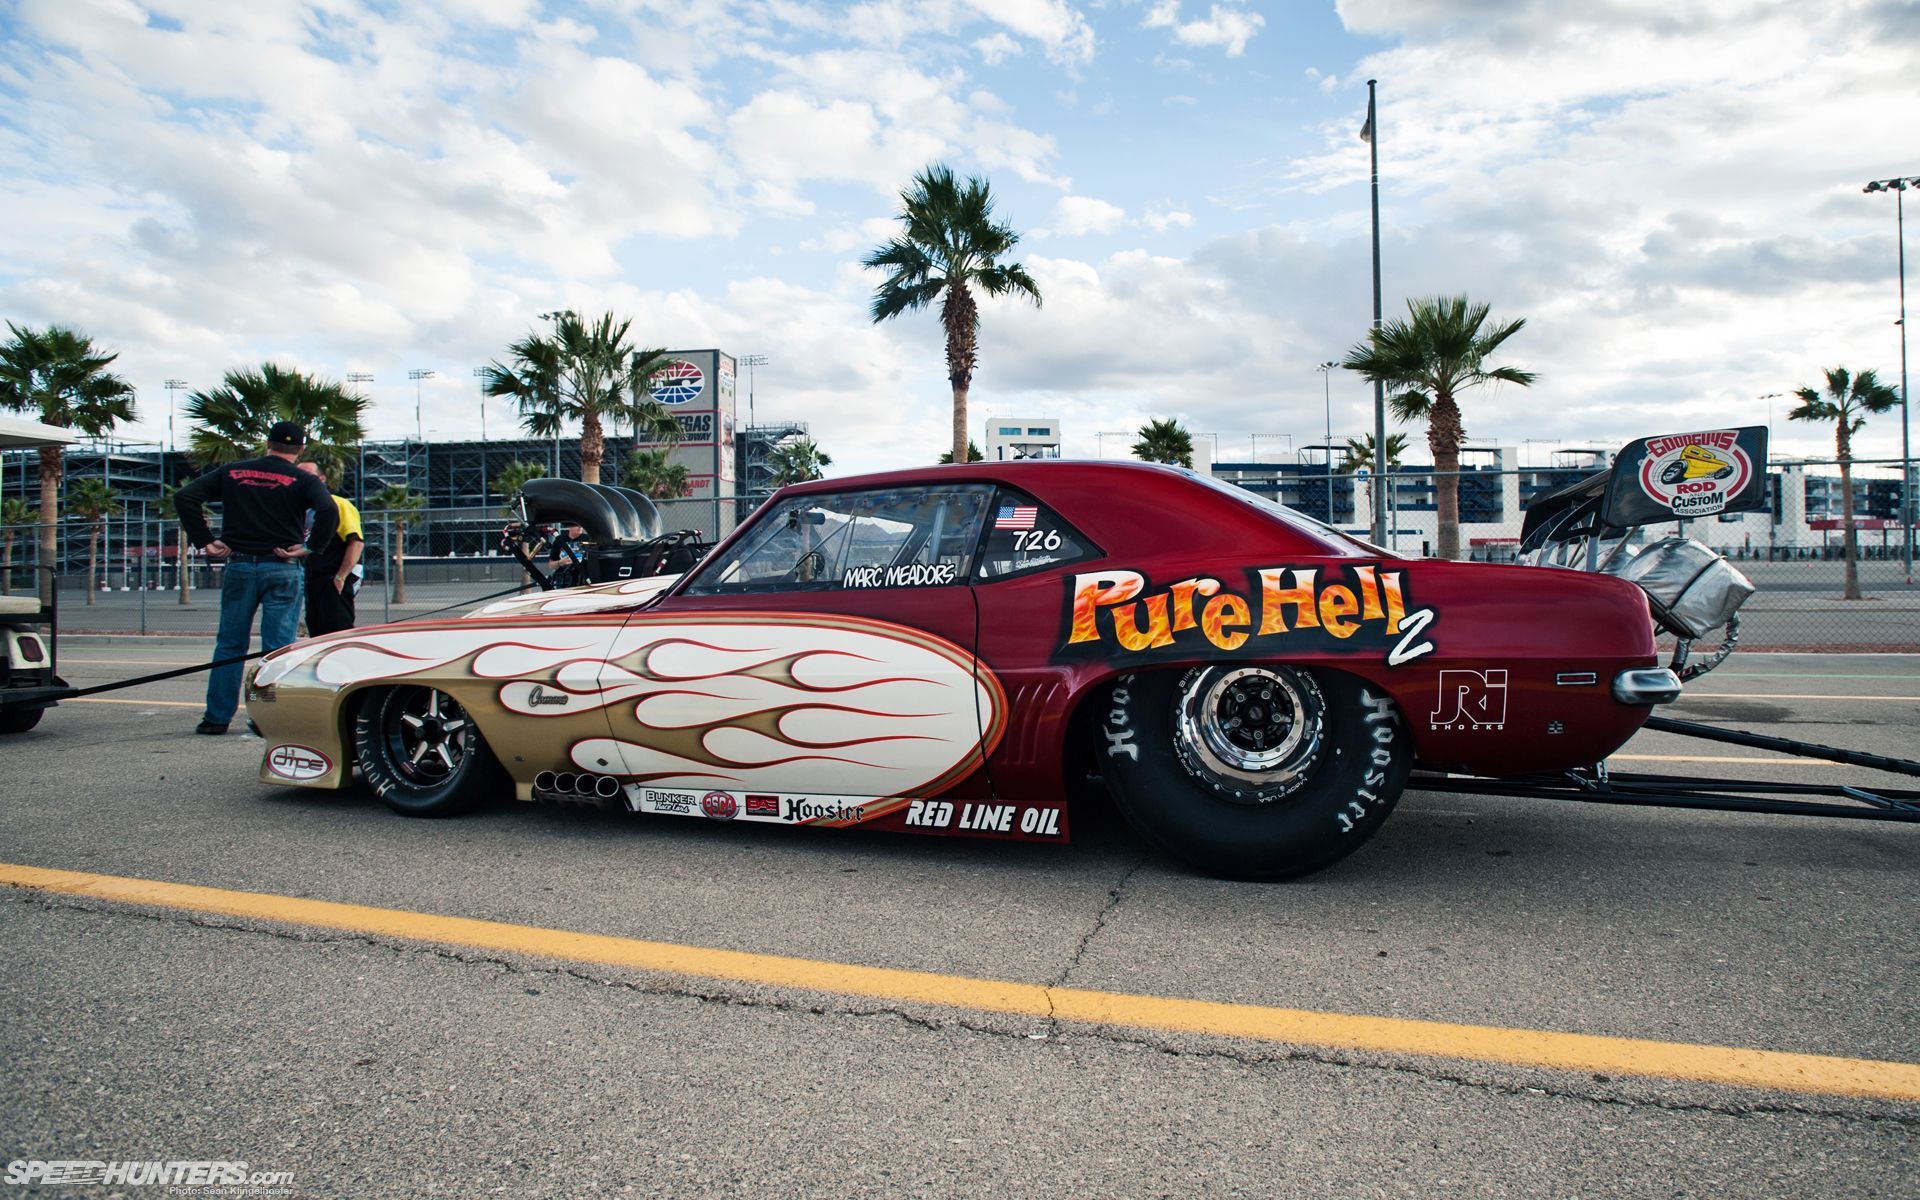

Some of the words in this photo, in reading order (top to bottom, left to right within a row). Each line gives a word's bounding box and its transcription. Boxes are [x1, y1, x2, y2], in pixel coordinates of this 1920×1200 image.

[1647, 432, 1737, 458] GOODGUYS
[1676, 481, 1717, 494] ROD
[1674, 504, 1723, 515] ASSOCIATION
[1013, 529, 1062, 551] 726
[843, 567, 883, 588] MARC
[885, 564, 955, 587] MEADORS
[1068, 570, 1251, 651] Pure
[1257, 565, 1405, 639] Hell
[1388, 608, 1434, 666] 2
[1338, 688, 1400, 833] Hoosier
[646, 790, 697, 806] BUNKER
[705, 796, 733, 813] PSCA
[783, 798, 864, 822] Hoosier
[905, 800, 954, 827] RED
[959, 803, 1016, 832] LINE
[1021, 807, 1060, 835] OIL
